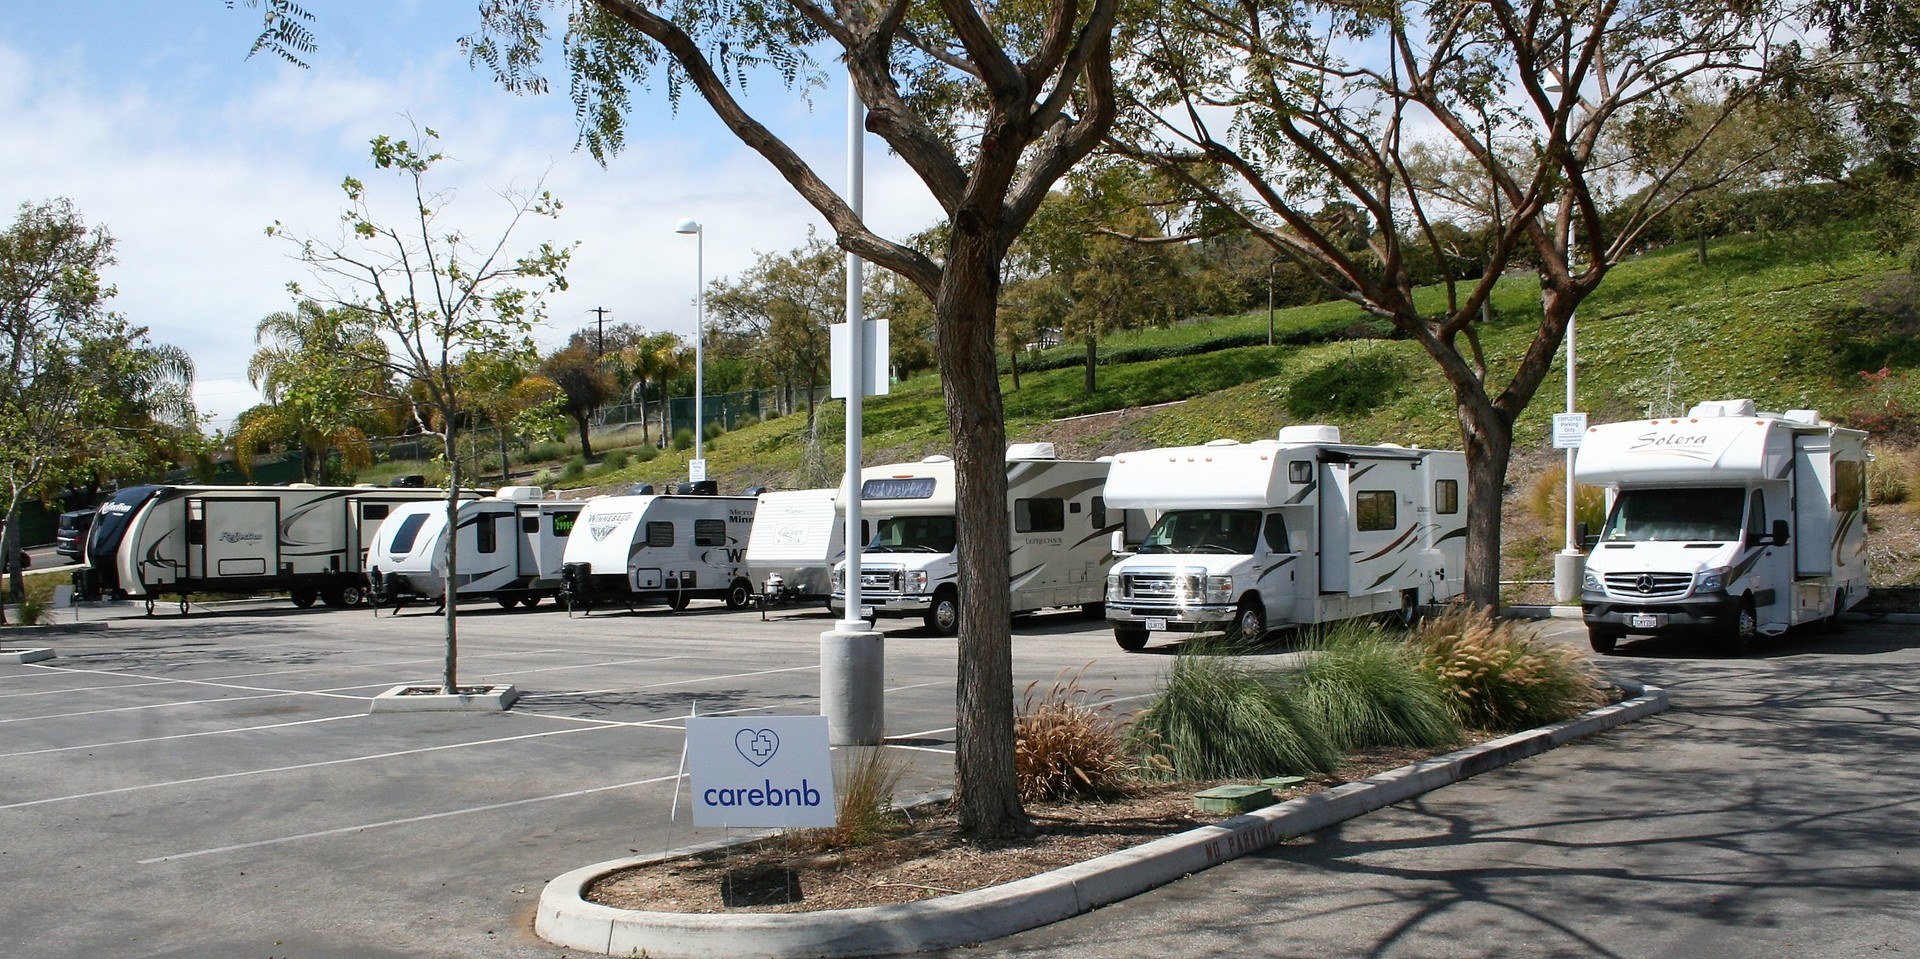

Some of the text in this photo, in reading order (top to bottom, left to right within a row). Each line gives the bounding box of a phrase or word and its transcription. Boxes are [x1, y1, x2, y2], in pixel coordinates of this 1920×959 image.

[1629, 431, 1708, 450] Solera
[704, 778, 821, 807] carebnb
[1228, 823, 1276, 854] PARKING
